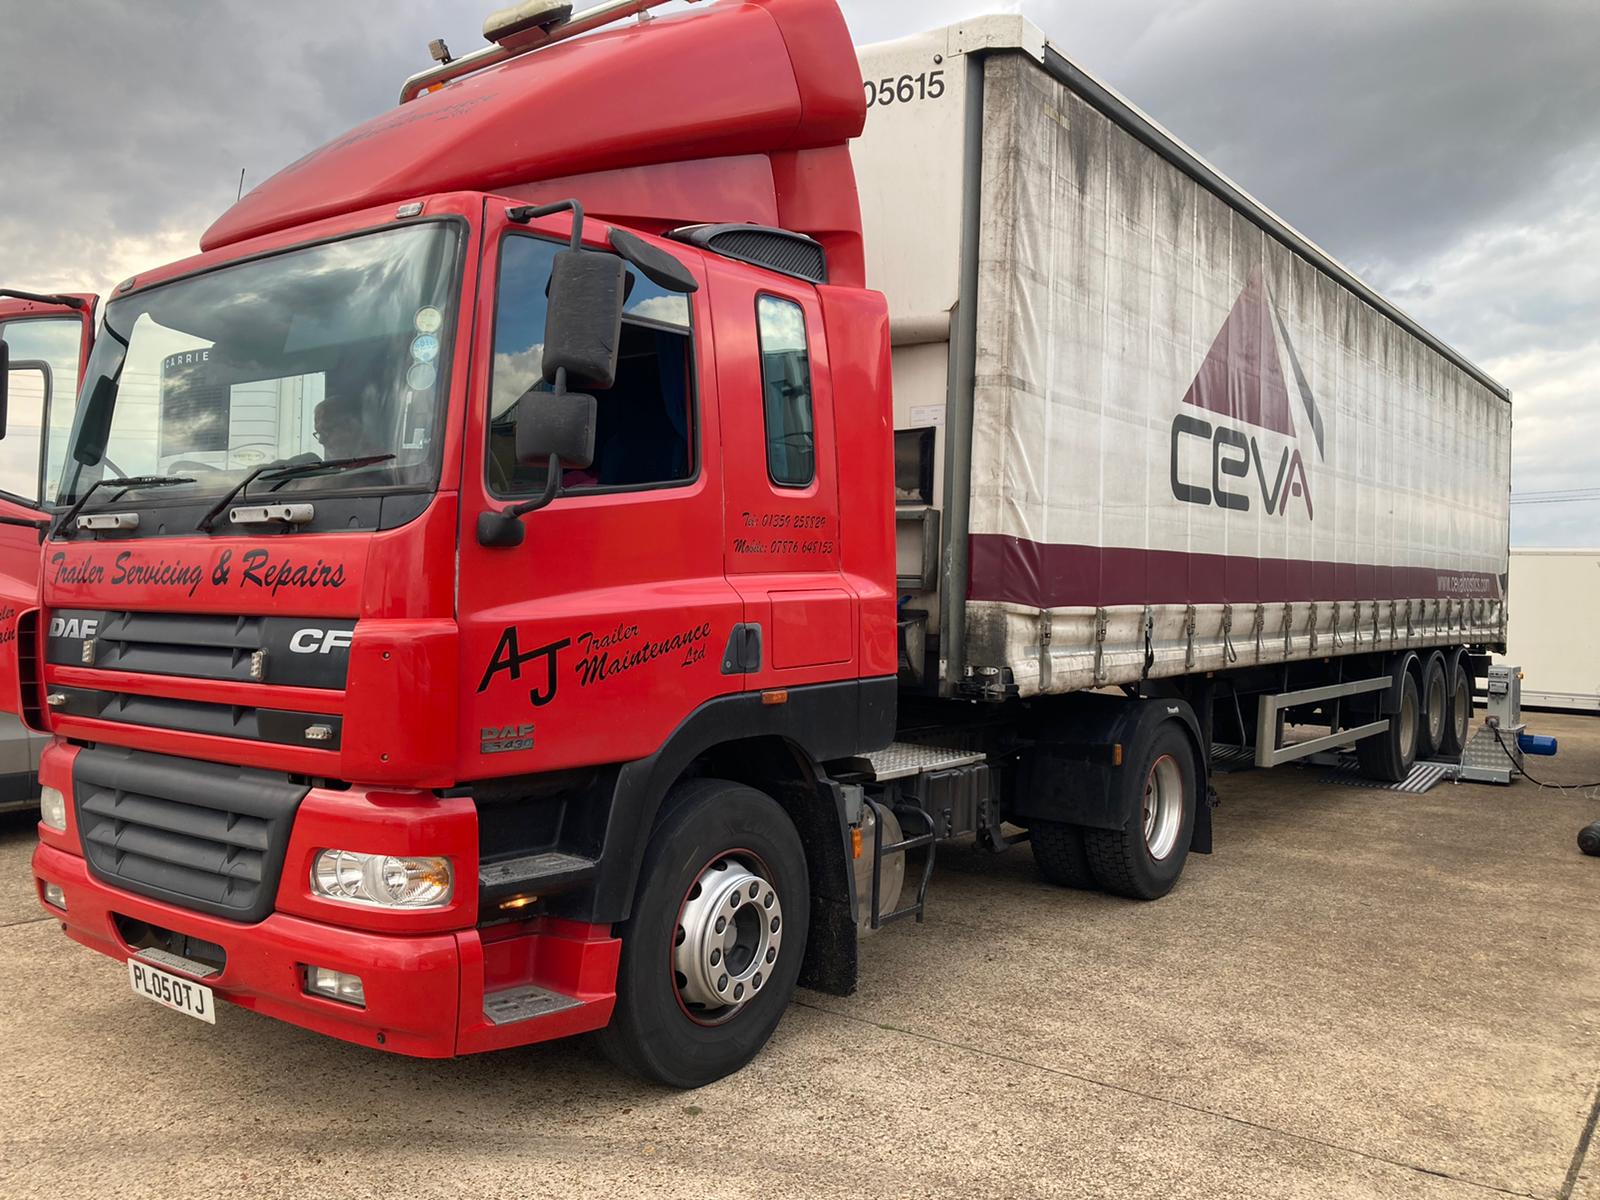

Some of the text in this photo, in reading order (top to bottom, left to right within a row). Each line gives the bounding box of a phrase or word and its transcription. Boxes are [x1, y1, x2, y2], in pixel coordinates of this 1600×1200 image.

[762, 513, 791, 528] 01359
[51, 549, 346, 597] Trailer Servicing & Repairs
[48, 617, 98, 639] DAF
[289, 628, 354, 654] CF
[577, 623, 639, 656] Trailer
[476, 626, 571, 707] AJ
[575, 622, 711, 687] Maintenance
[681, 643, 706, 667] Ltd
[480, 724, 535, 740] DAF
